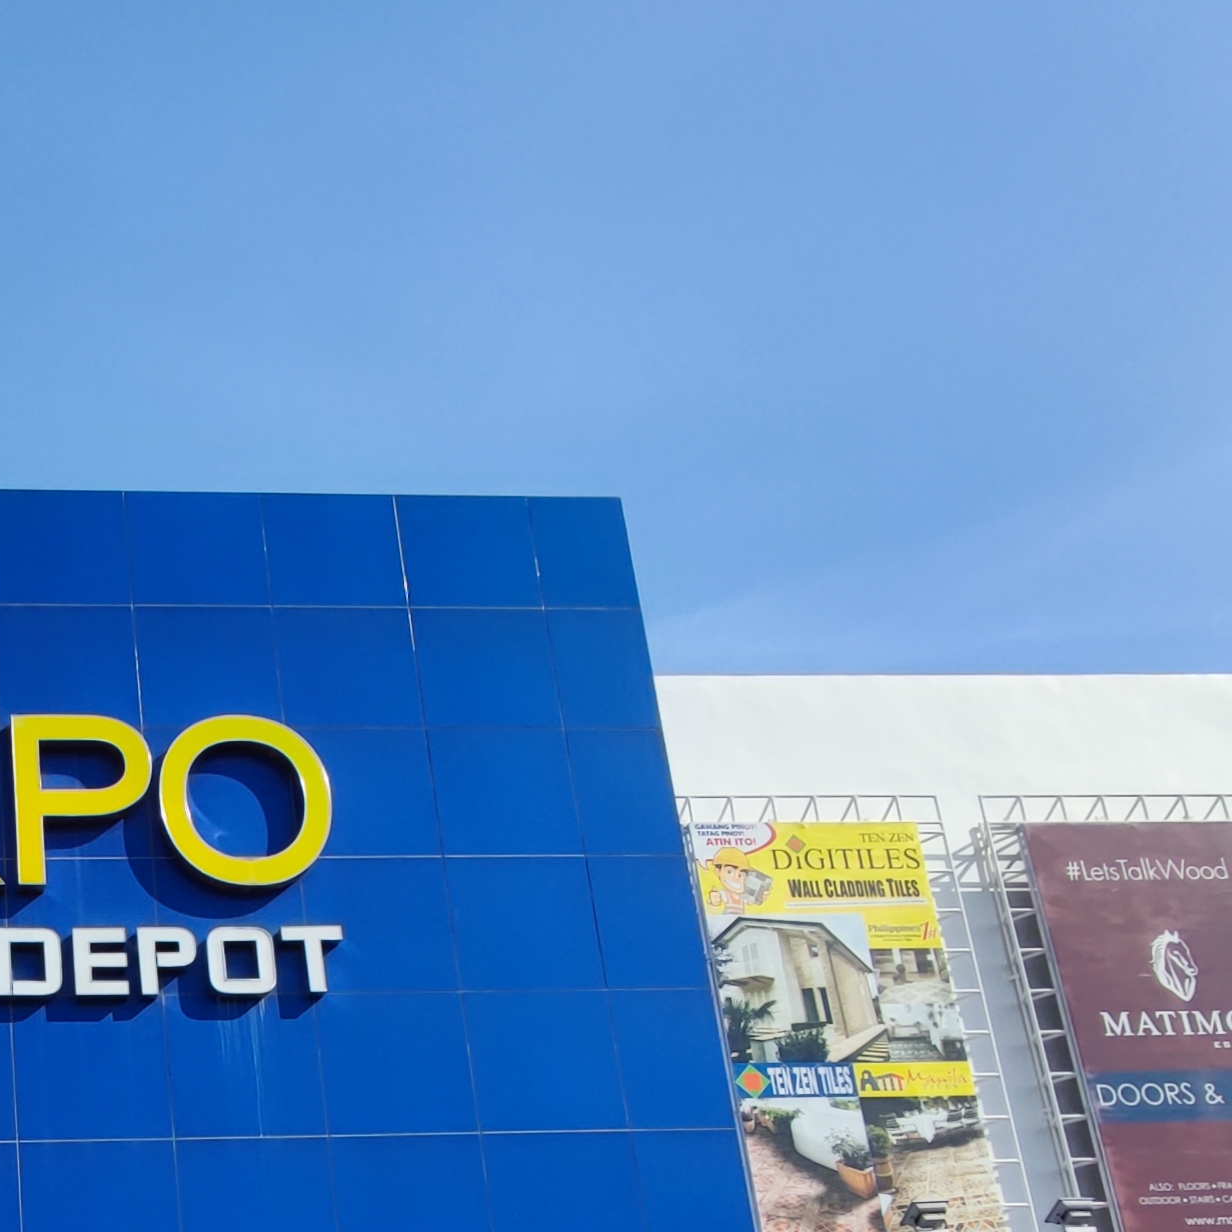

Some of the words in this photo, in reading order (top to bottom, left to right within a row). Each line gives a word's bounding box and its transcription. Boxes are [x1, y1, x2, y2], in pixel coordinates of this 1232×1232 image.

[706, 838, 732, 846] ATIN
[735, 838, 757, 846] ITO!
[859, 832, 886, 843] TEN
[888, 832, 915, 843] ZEN
[1066, 857, 1229, 881] #LetsTalkWood
[787, 878, 822, 898] WALL
[823, 877, 885, 898] CLADDING
[886, 877, 921, 897] TILES
[769, 1066, 794, 1096] TEN
[793, 1066, 818, 1096] ZEN
[818, 1065, 853, 1095] TILES
[1096, 1082, 1196, 1107] DOORS
[1204, 1083, 1225, 1104] &
